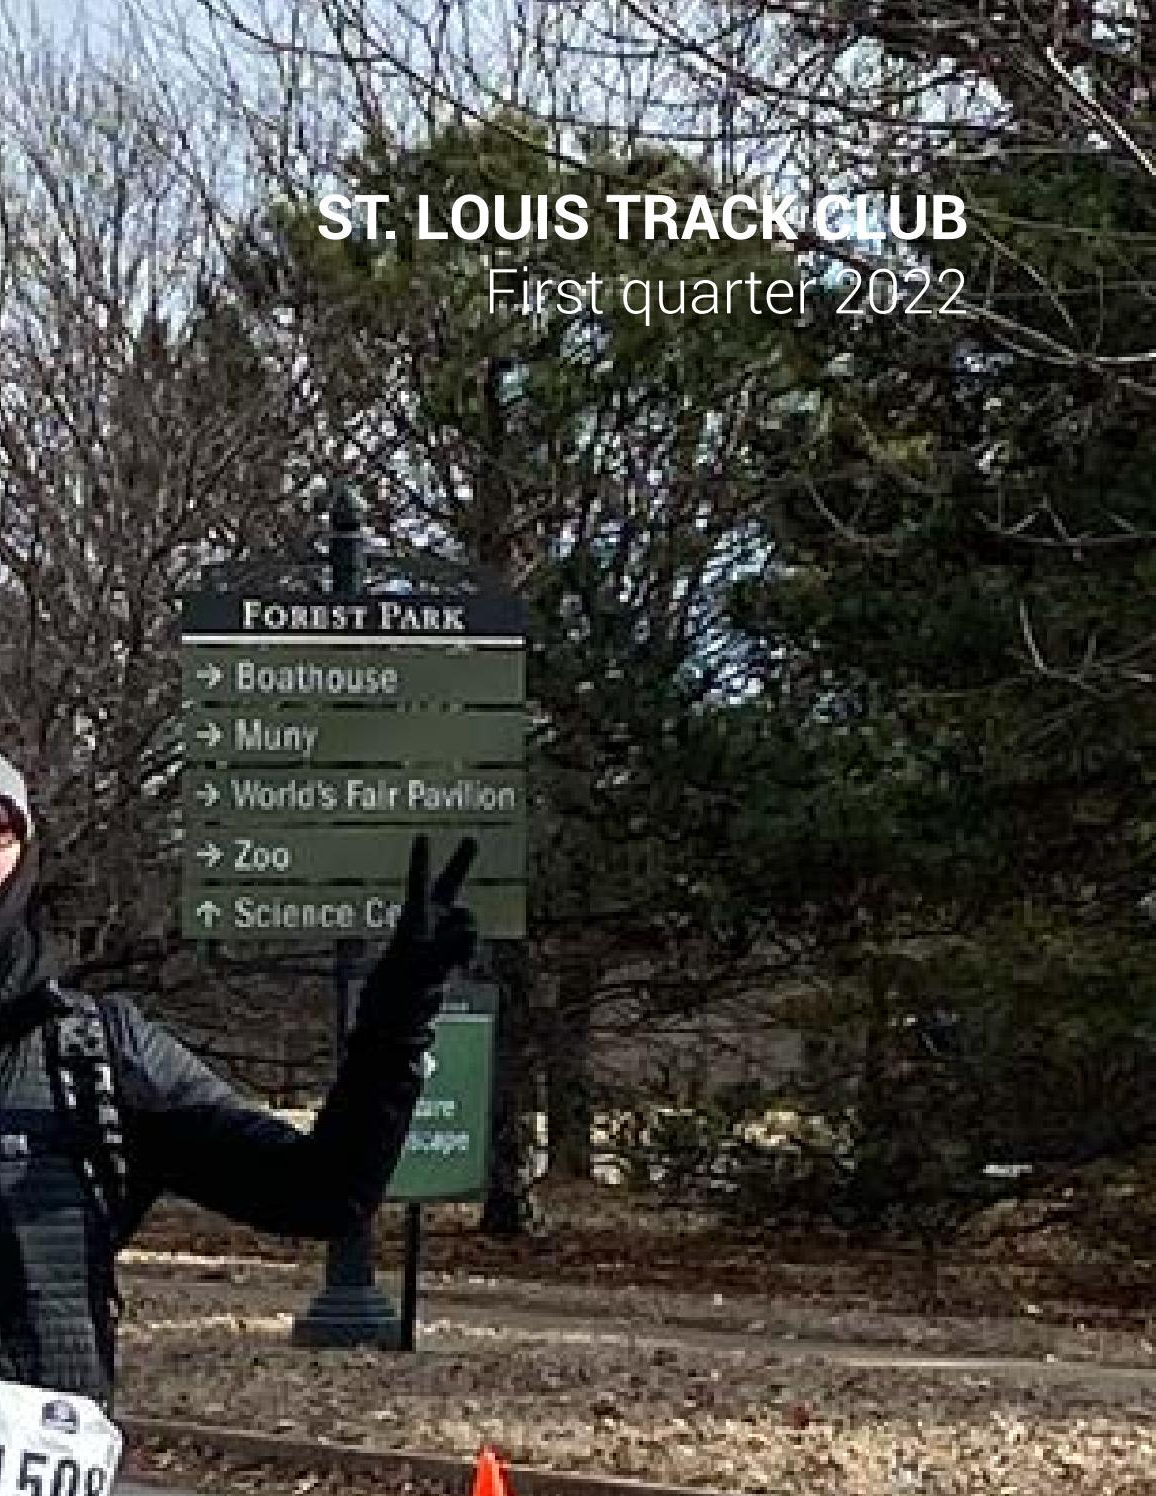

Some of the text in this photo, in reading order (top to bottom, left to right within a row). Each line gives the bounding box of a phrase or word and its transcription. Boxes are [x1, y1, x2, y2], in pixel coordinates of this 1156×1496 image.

[237, 660, 399, 694] Boathouse
[235, 719, 319, 758] Muny
[231, 778, 516, 811] World's Fair Pavilion
[234, 839, 291, 872] Zoo
[234, 896, 353, 928] Science
